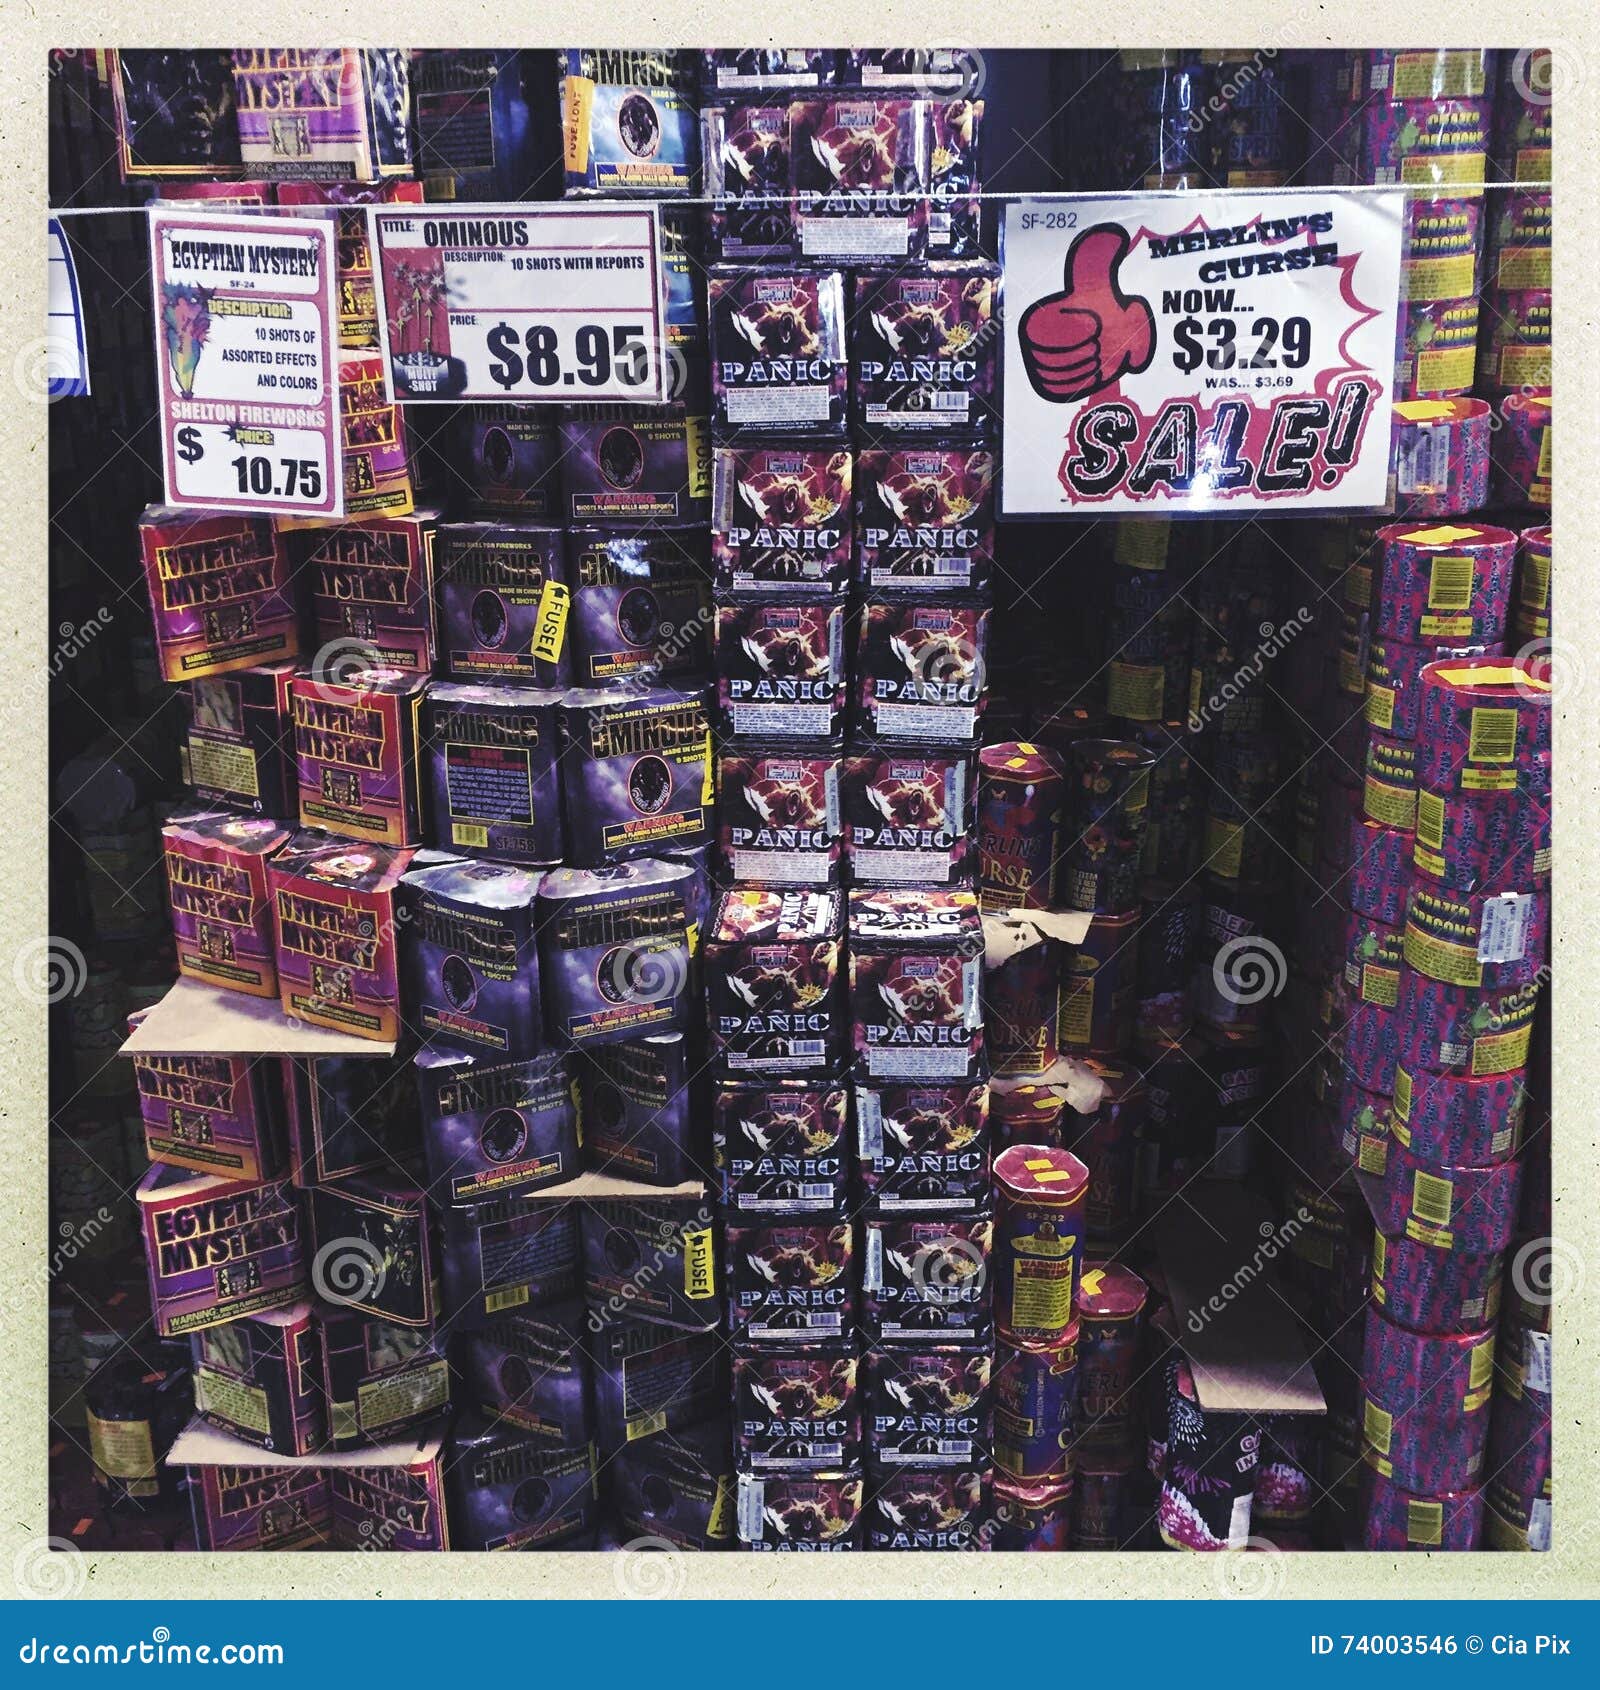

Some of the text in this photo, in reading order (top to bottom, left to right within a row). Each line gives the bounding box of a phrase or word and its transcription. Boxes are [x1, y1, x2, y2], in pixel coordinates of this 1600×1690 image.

[800, 190, 911, 212] PANIC
[1021, 212, 1078, 229] SF-282
[423, 220, 529, 247] OMINOUS
[1147, 211, 1334, 259] MERLIN'S
[172, 241, 318, 277] EGYPTIAN MYSTERY
[511, 256, 645, 271] 10 SHOTS WITH REPORTS
[1198, 243, 1338, 284] CURSE
[208, 299, 292, 319] DESCRIPTION:
[1161, 289, 1254, 314] NOW...
[255, 327, 315, 344] 10 SHOTS OF
[1172, 315, 1312, 375] $3.29
[222, 349, 317, 367] ASSORTED EFFECTS
[486, 322, 649, 390] $8.95
[722, 360, 832, 382] PANIC
[861, 360, 977, 382] PANIC
[1255, 374, 1294, 388] $3.69
[257, 374, 318, 391] AND COLORS
[171, 401, 326, 428] SHELTON FIREWORKS
[177, 426, 204, 465] $
[235, 428, 275, 446] PRICE:
[1064, 378, 1372, 497] SALE!
[232, 455, 322, 499] 10.75
[728, 528, 840, 549] PANIC
[865, 528, 978, 549] PANIC
[539, 601, 563, 646] FUSE
[731, 679, 834, 699] PANIC
[875, 679, 978, 701] PANIC
[591, 709, 710, 760] OMINOUS
[731, 827, 833, 848] PANIC
[853, 827, 955, 848] PANIC
[777, 891, 803, 934] PANIC
[856, 912, 961, 924] PANIC
[720, 1013, 830, 1034] PANIC
[866, 1024, 972, 1043] PANIC
[732, 1158, 840, 1177] PANIC
[873, 1153, 981, 1173] PANIC
[690, 1248, 708, 1288] FUSE
[740, 1288, 846, 1307] PANIC
[875, 1286, 982, 1303] PANIC
[744, 1420, 848, 1437] PANIC
[874, 1416, 978, 1434] PANIC
[872, 1532, 970, 1548] PANIC
